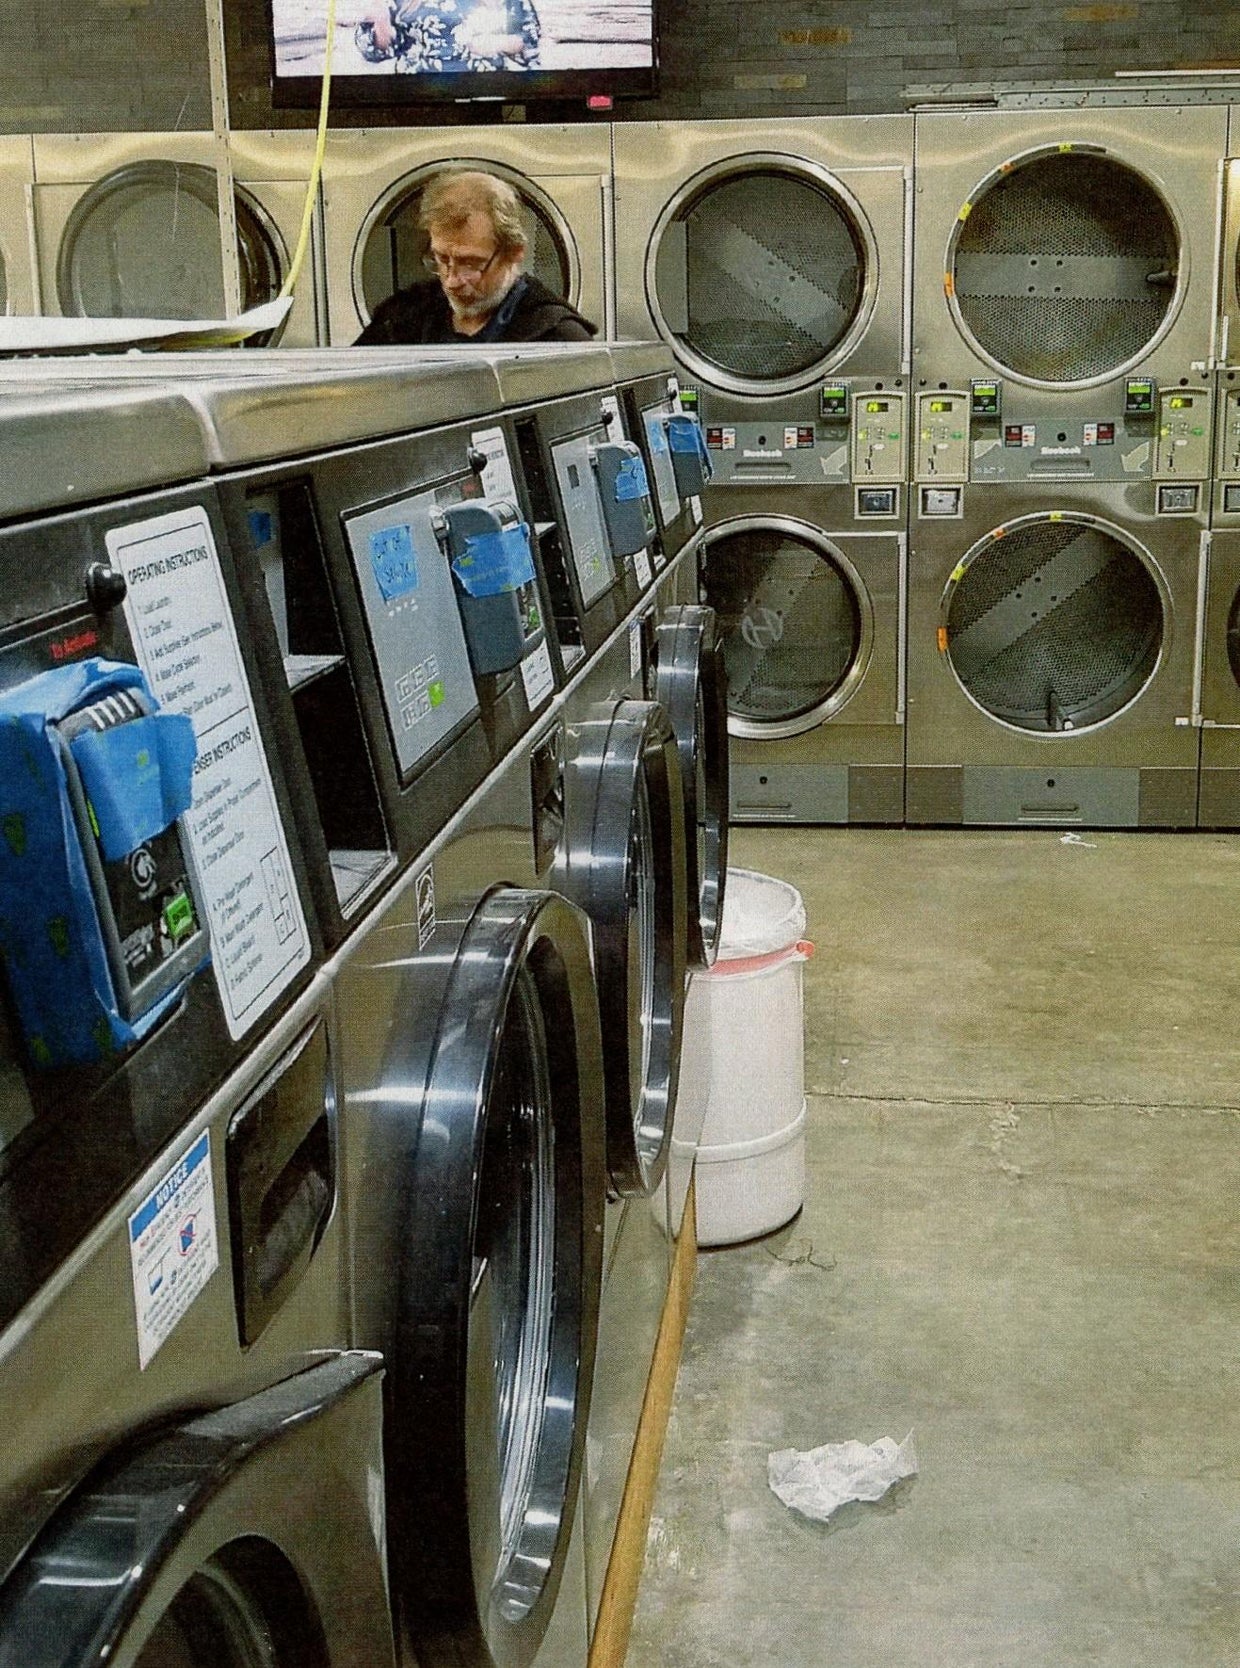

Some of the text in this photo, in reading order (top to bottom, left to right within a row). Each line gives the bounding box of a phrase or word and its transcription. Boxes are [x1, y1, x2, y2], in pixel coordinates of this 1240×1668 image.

[128, 545, 208, 585] OPERATING INSTRUCTIONS
[212, 726, 251, 761] INSTRUCTIONS
[156, 1163, 188, 1210] NOTICE
